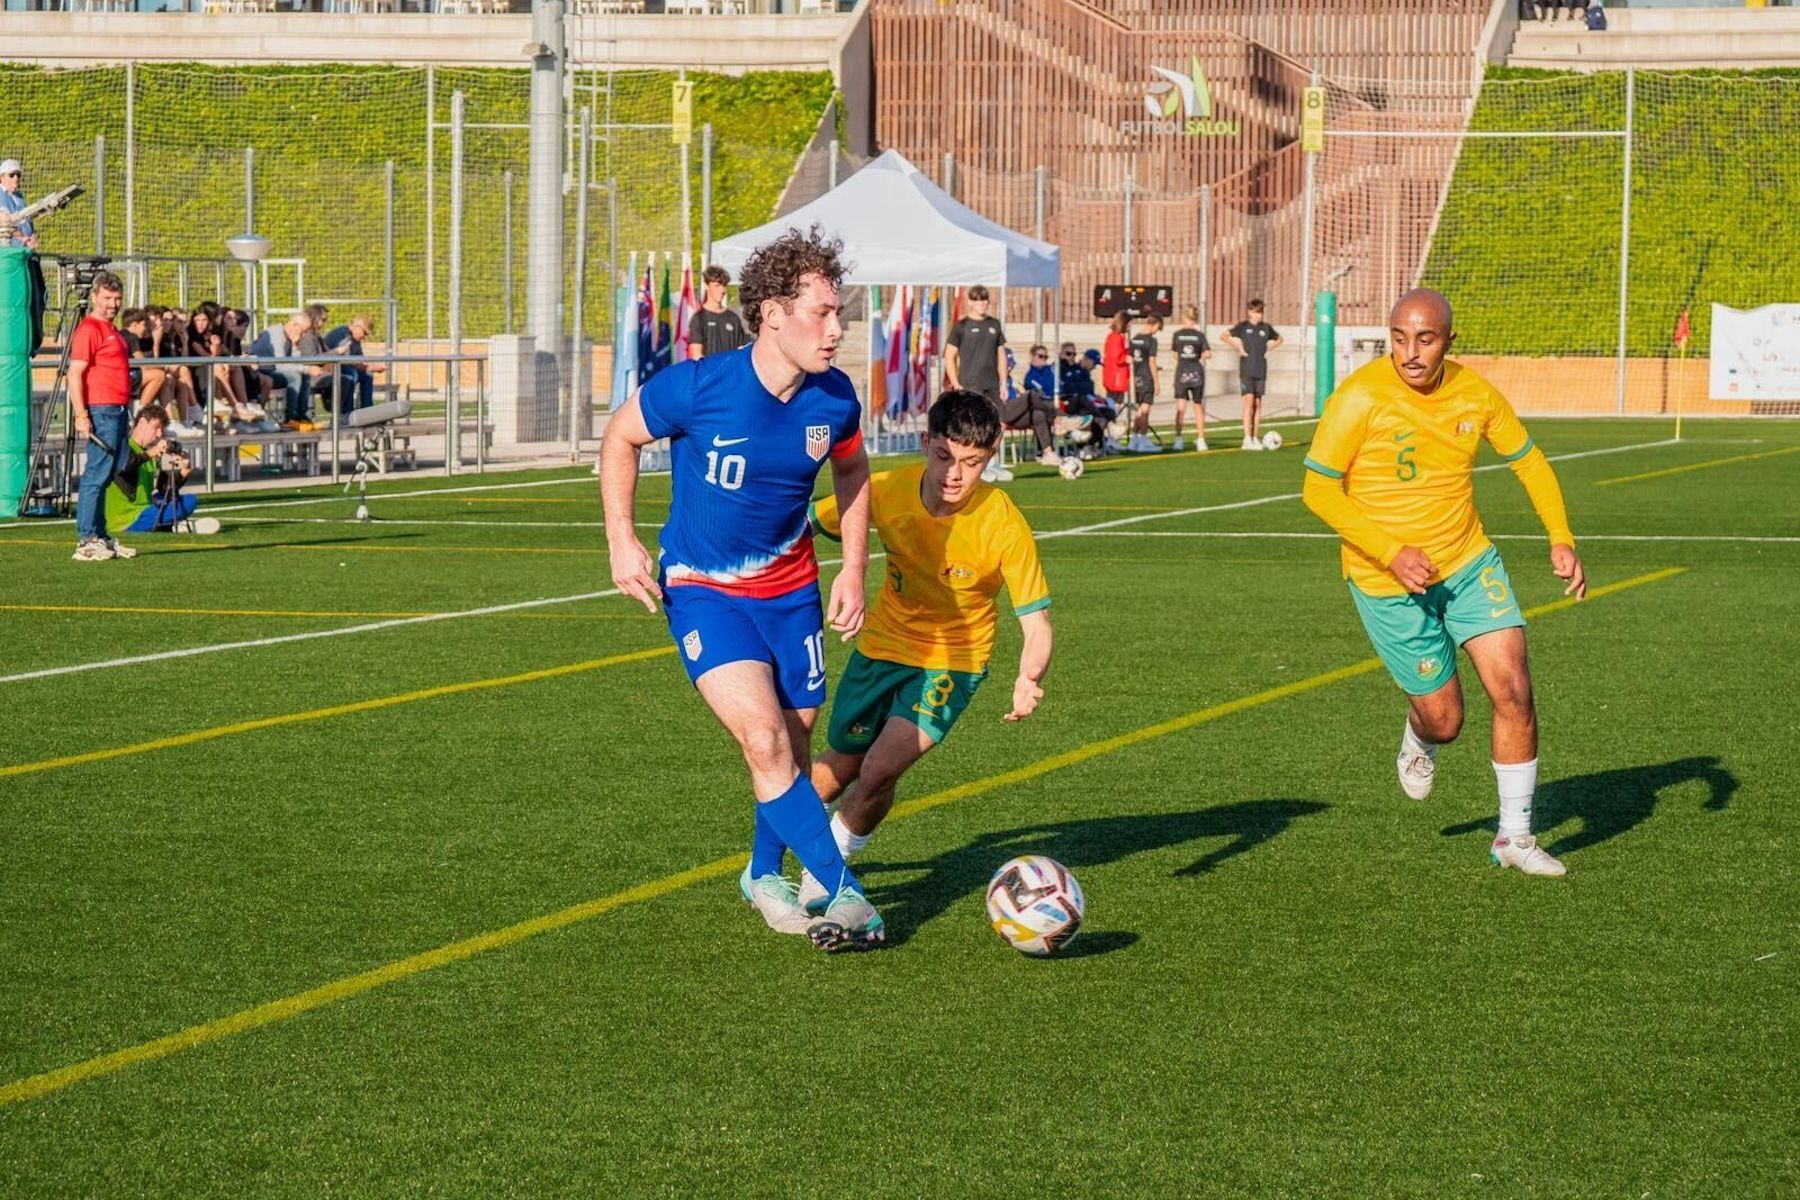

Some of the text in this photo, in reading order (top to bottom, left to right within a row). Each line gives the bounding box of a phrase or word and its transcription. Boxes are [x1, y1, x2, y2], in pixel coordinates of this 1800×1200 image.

[676, 86, 687, 102] 7
[1307, 91, 1321, 109] 8
[808, 427, 828, 441] USA
[705, 450, 746, 490] 10
[1396, 447, 1417, 481] 5
[1480, 567, 1508, 602] 5
[926, 673, 954, 707] 8
